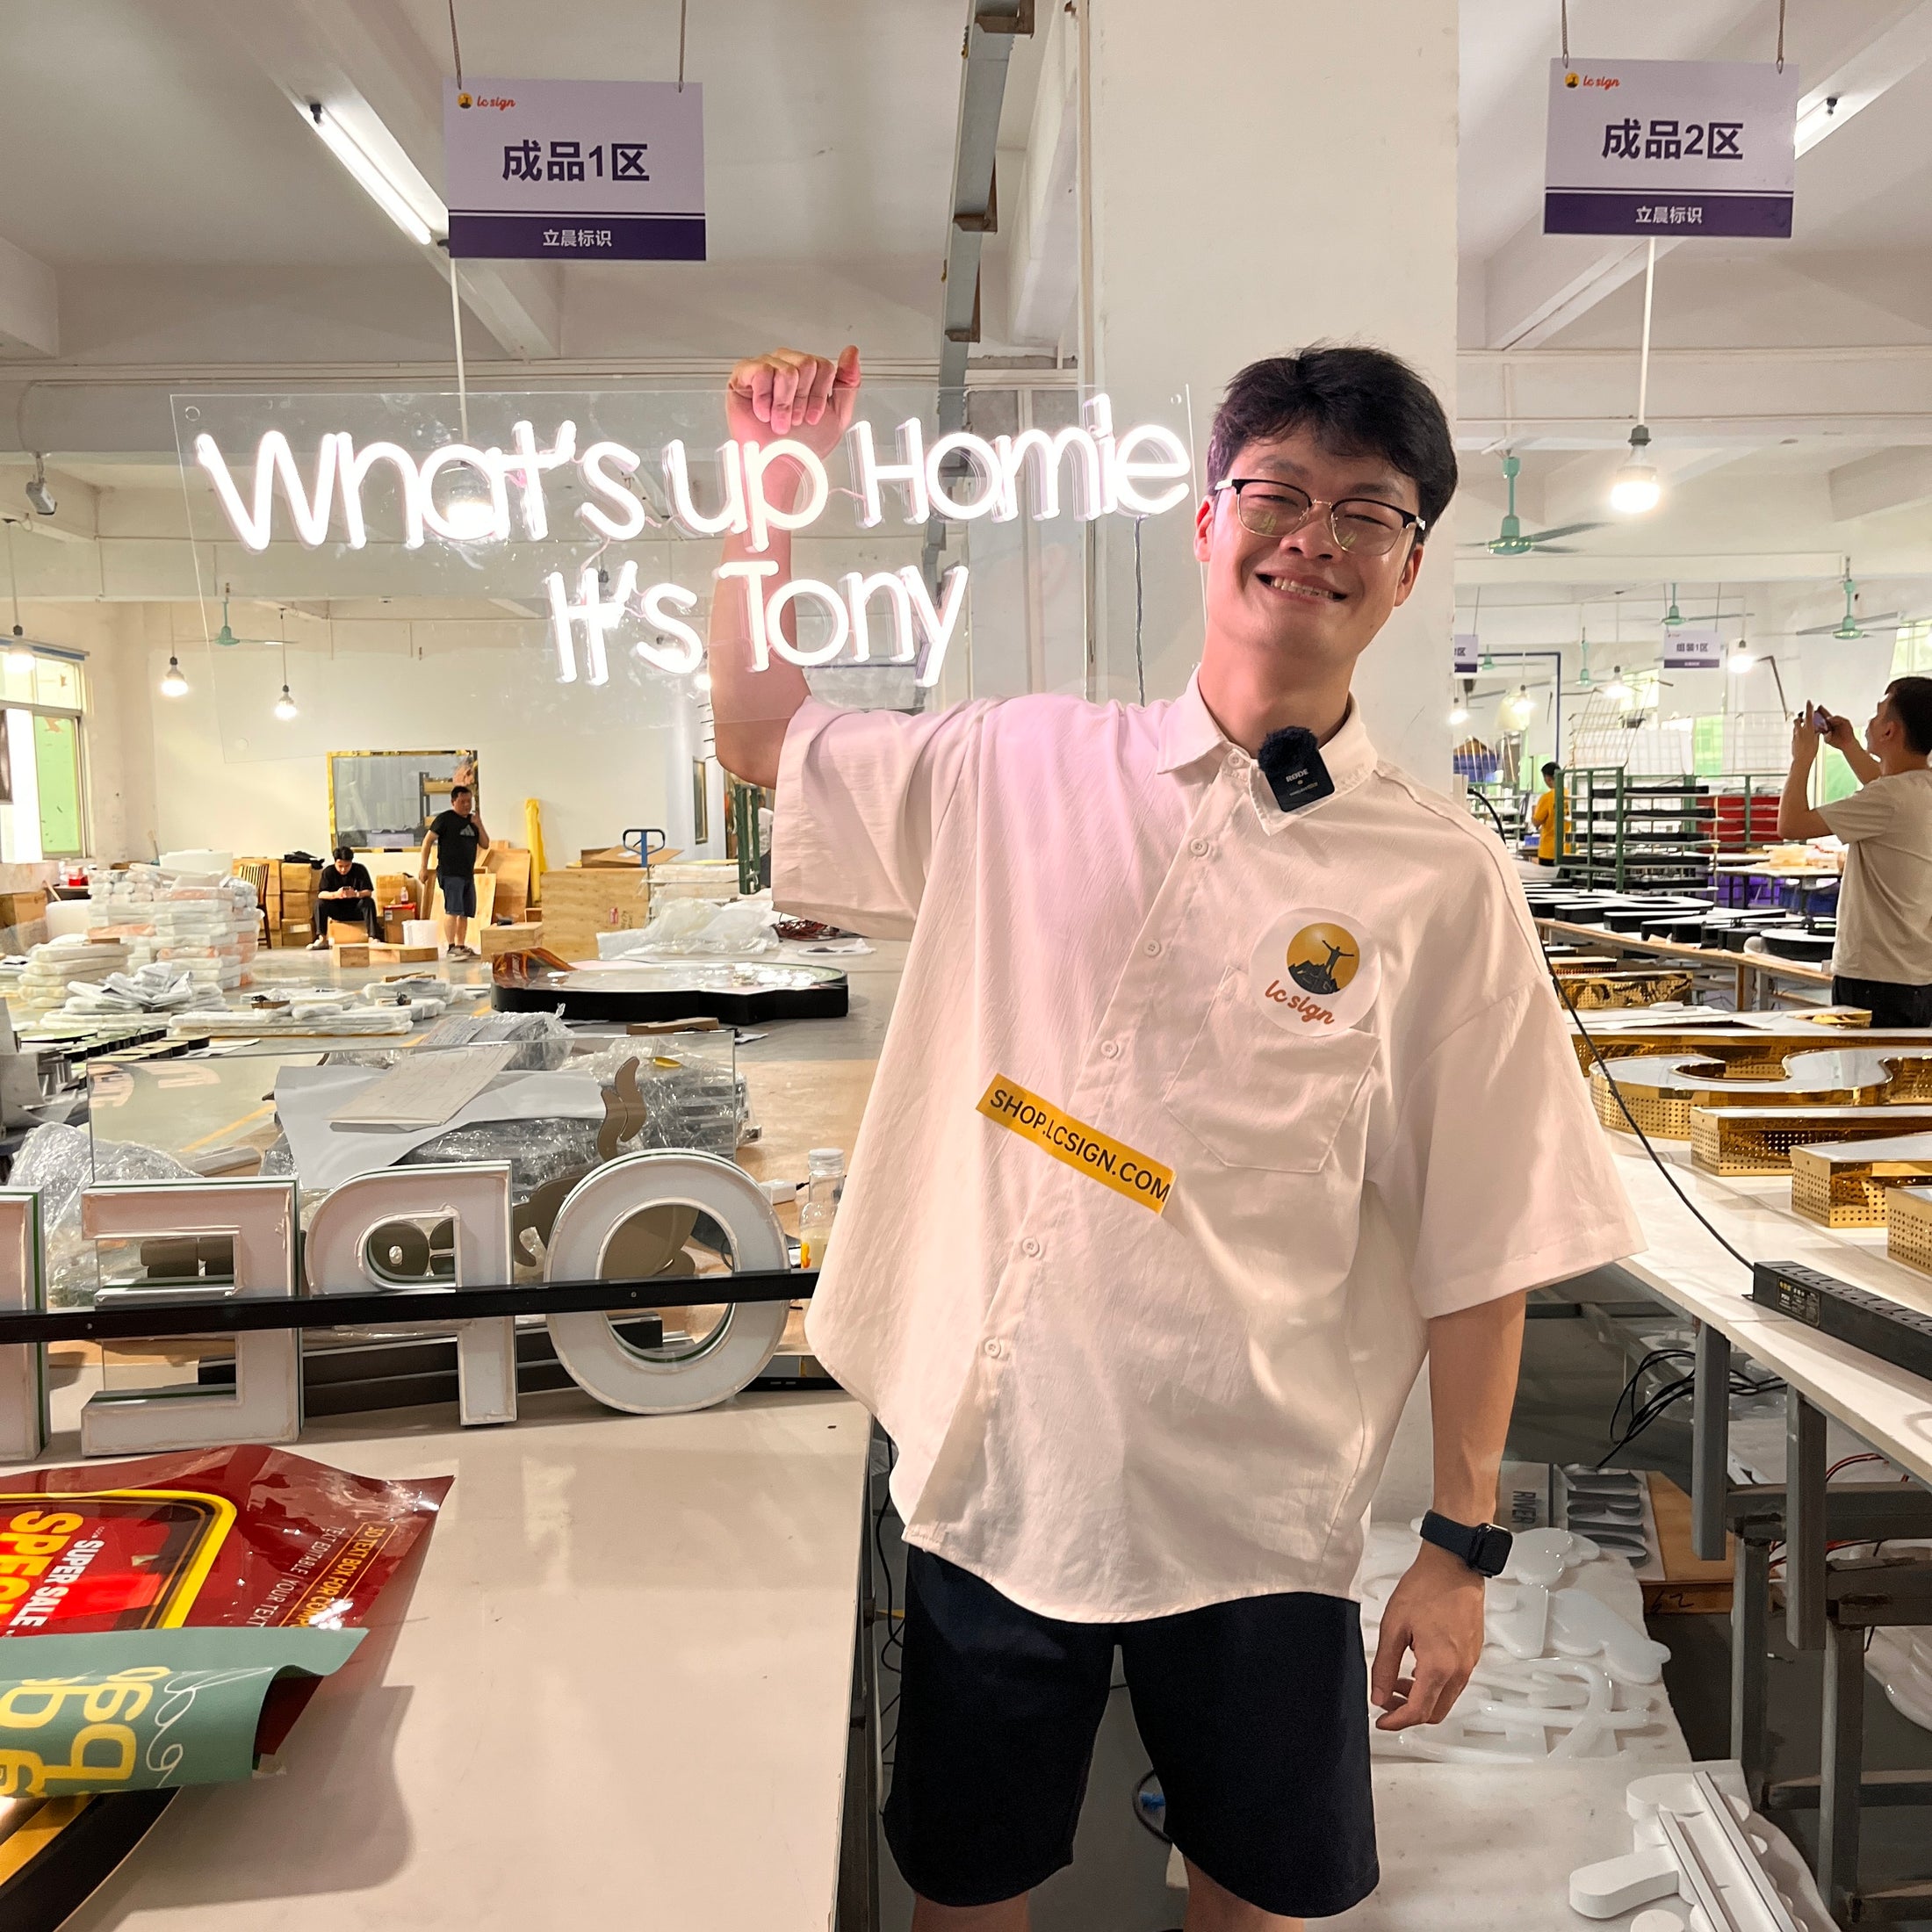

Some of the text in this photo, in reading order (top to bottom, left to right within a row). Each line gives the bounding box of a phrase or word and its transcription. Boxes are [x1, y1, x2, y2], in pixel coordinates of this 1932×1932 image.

[1602, 119, 1743, 159] 成品2区
[502, 140, 650, 181] 成品1区
[1636, 206, 1702, 224] 立晨标识
[543, 229, 612, 247] 立晨标识
[195, 393, 1191, 552] What's up Homie
[544, 560, 969, 687] It's Tony
[1287, 996, 1335, 1025] sign
[990, 1089, 1171, 1202] SHOP.LCSIGN.COM
[331, 1558, 362, 1577] BOX
[347, 1539, 378, 1559] TEXT
[9, 1539, 105, 1626] SUPER SALE
[247, 1526, 346, 1627] TEXT EDITABLE YOUR TEXT
[316, 1576, 348, 1596] FOR
